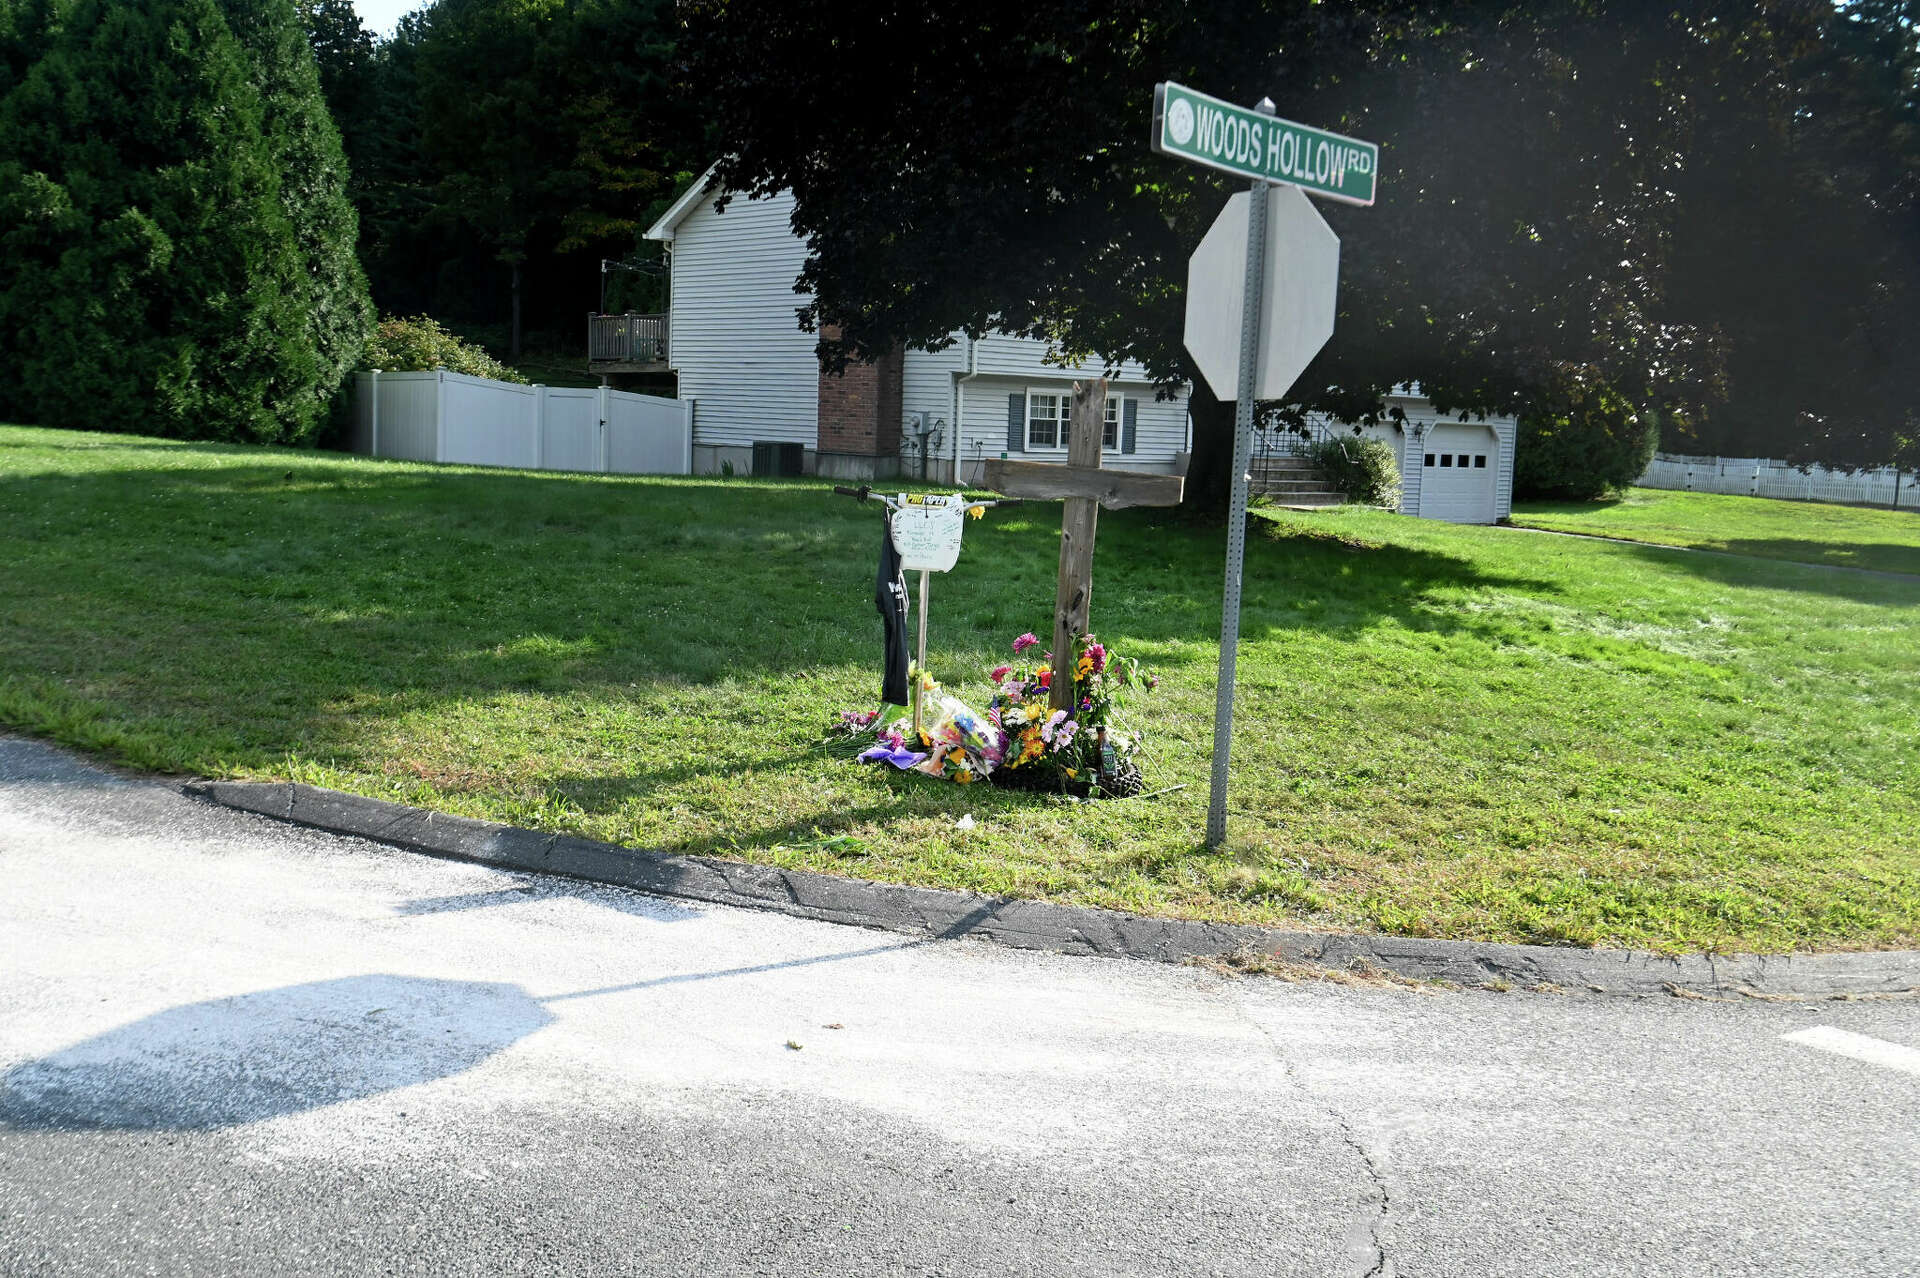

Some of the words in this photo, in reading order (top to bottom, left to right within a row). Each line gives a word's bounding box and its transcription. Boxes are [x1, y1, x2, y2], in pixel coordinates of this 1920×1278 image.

[1197, 103, 1262, 167] WOODS
[1267, 126, 1348, 188] HOLLOW
[1348, 149, 1371, 173] RD
